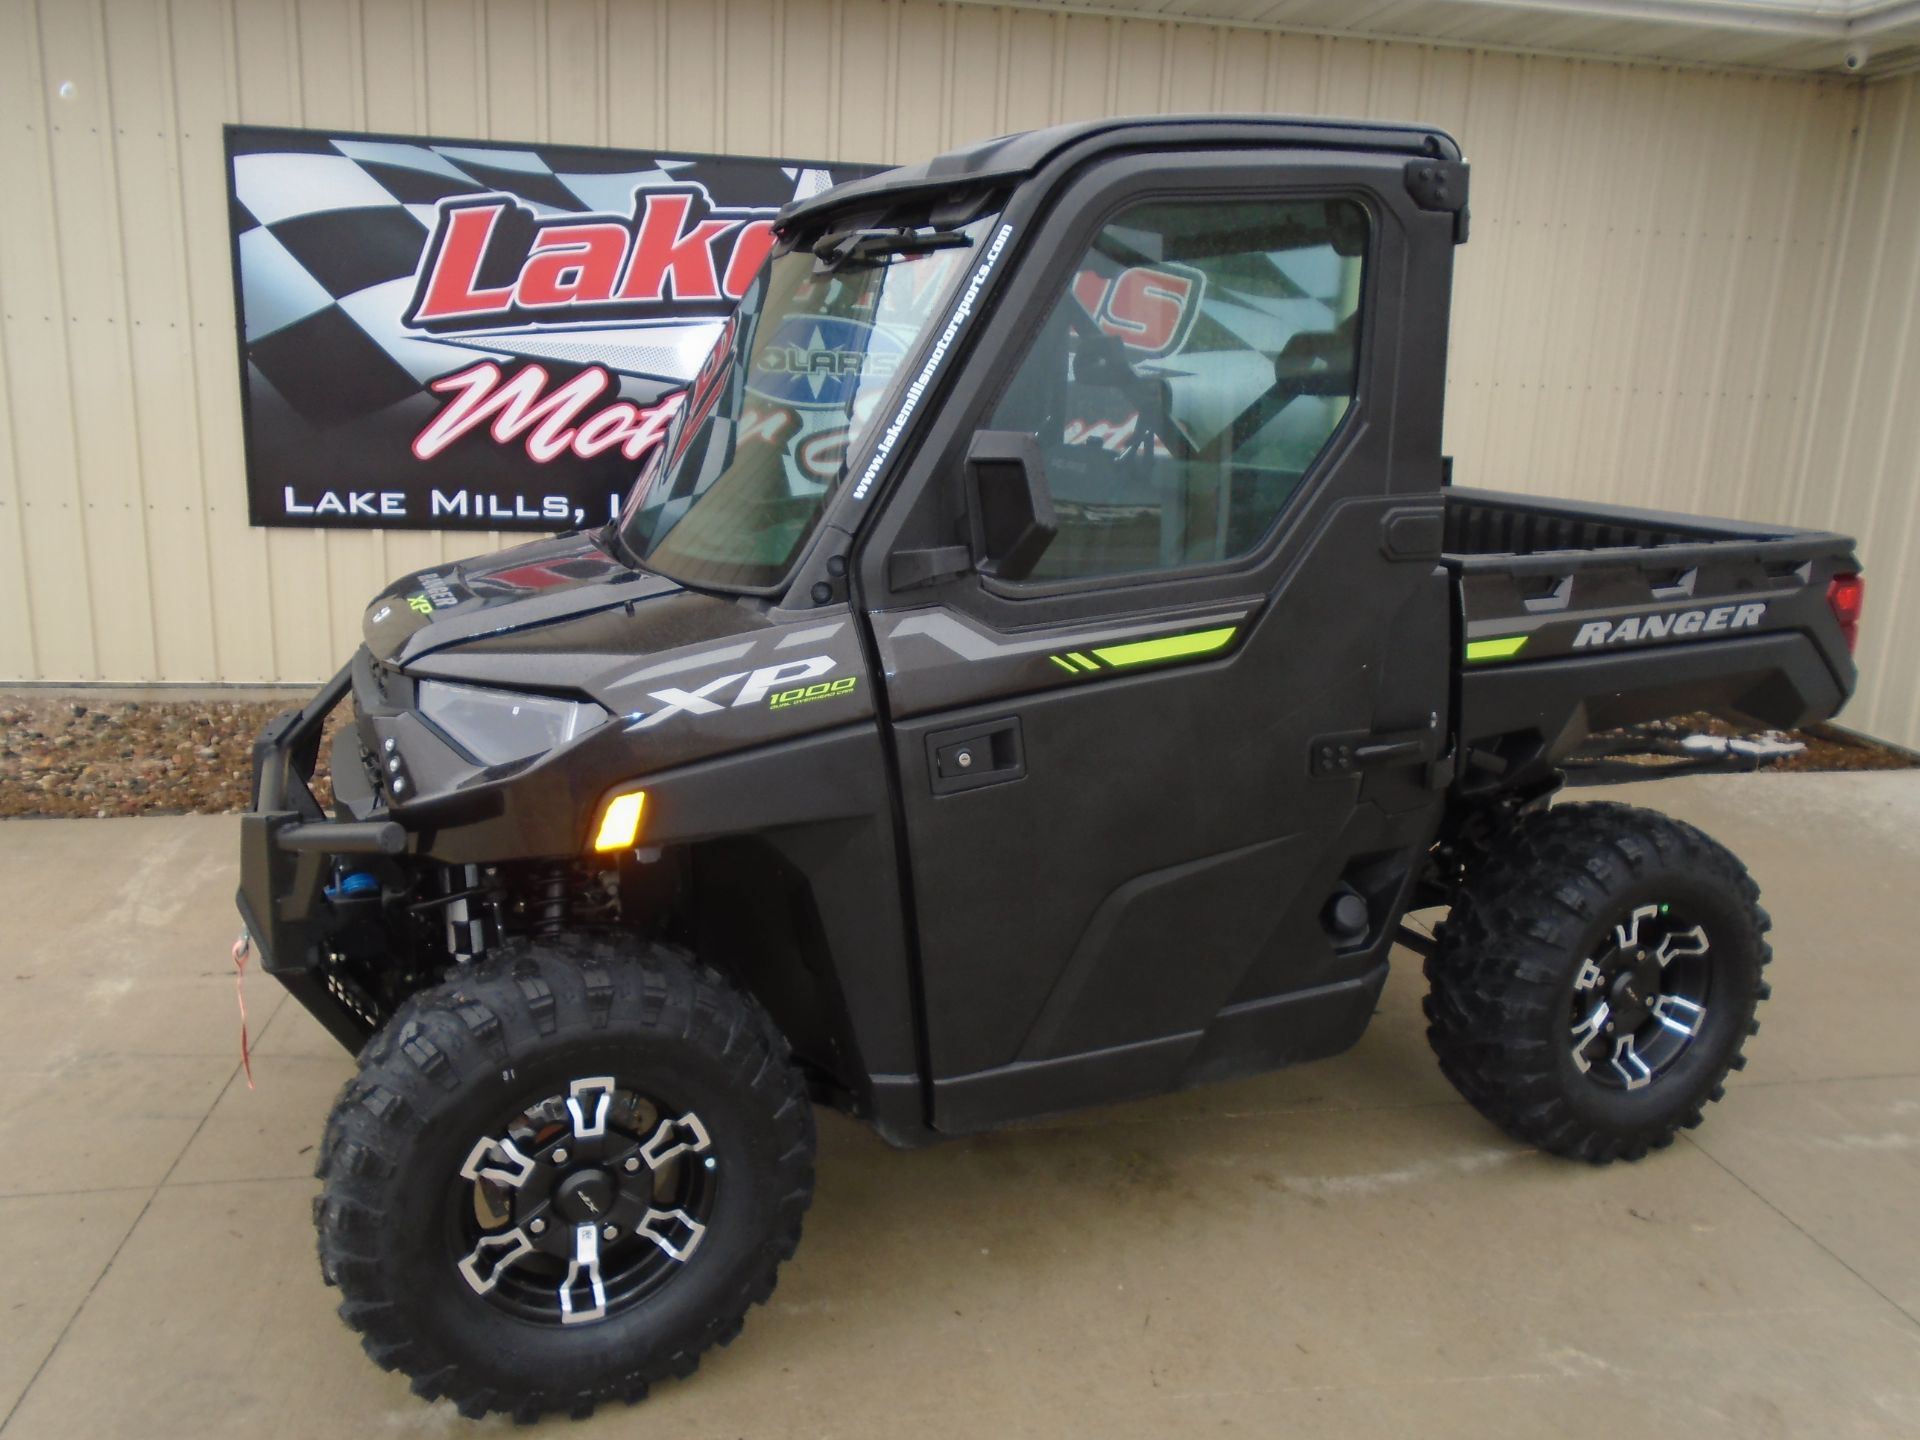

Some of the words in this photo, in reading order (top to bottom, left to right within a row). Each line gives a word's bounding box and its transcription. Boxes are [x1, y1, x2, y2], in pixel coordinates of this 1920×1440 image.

[756, 347, 906, 376] OLARIS
[853, 224, 1013, 500] www.lakemillsmotorsports.com
[284, 486, 406, 515] LAKE
[431, 489, 585, 524] MILLS,
[406, 594, 433, 613] XP
[416, 573, 458, 607] RANGER
[1572, 602, 1767, 649] RANGER
[622, 655, 837, 732] XP
[770, 677, 856, 705] 1000
